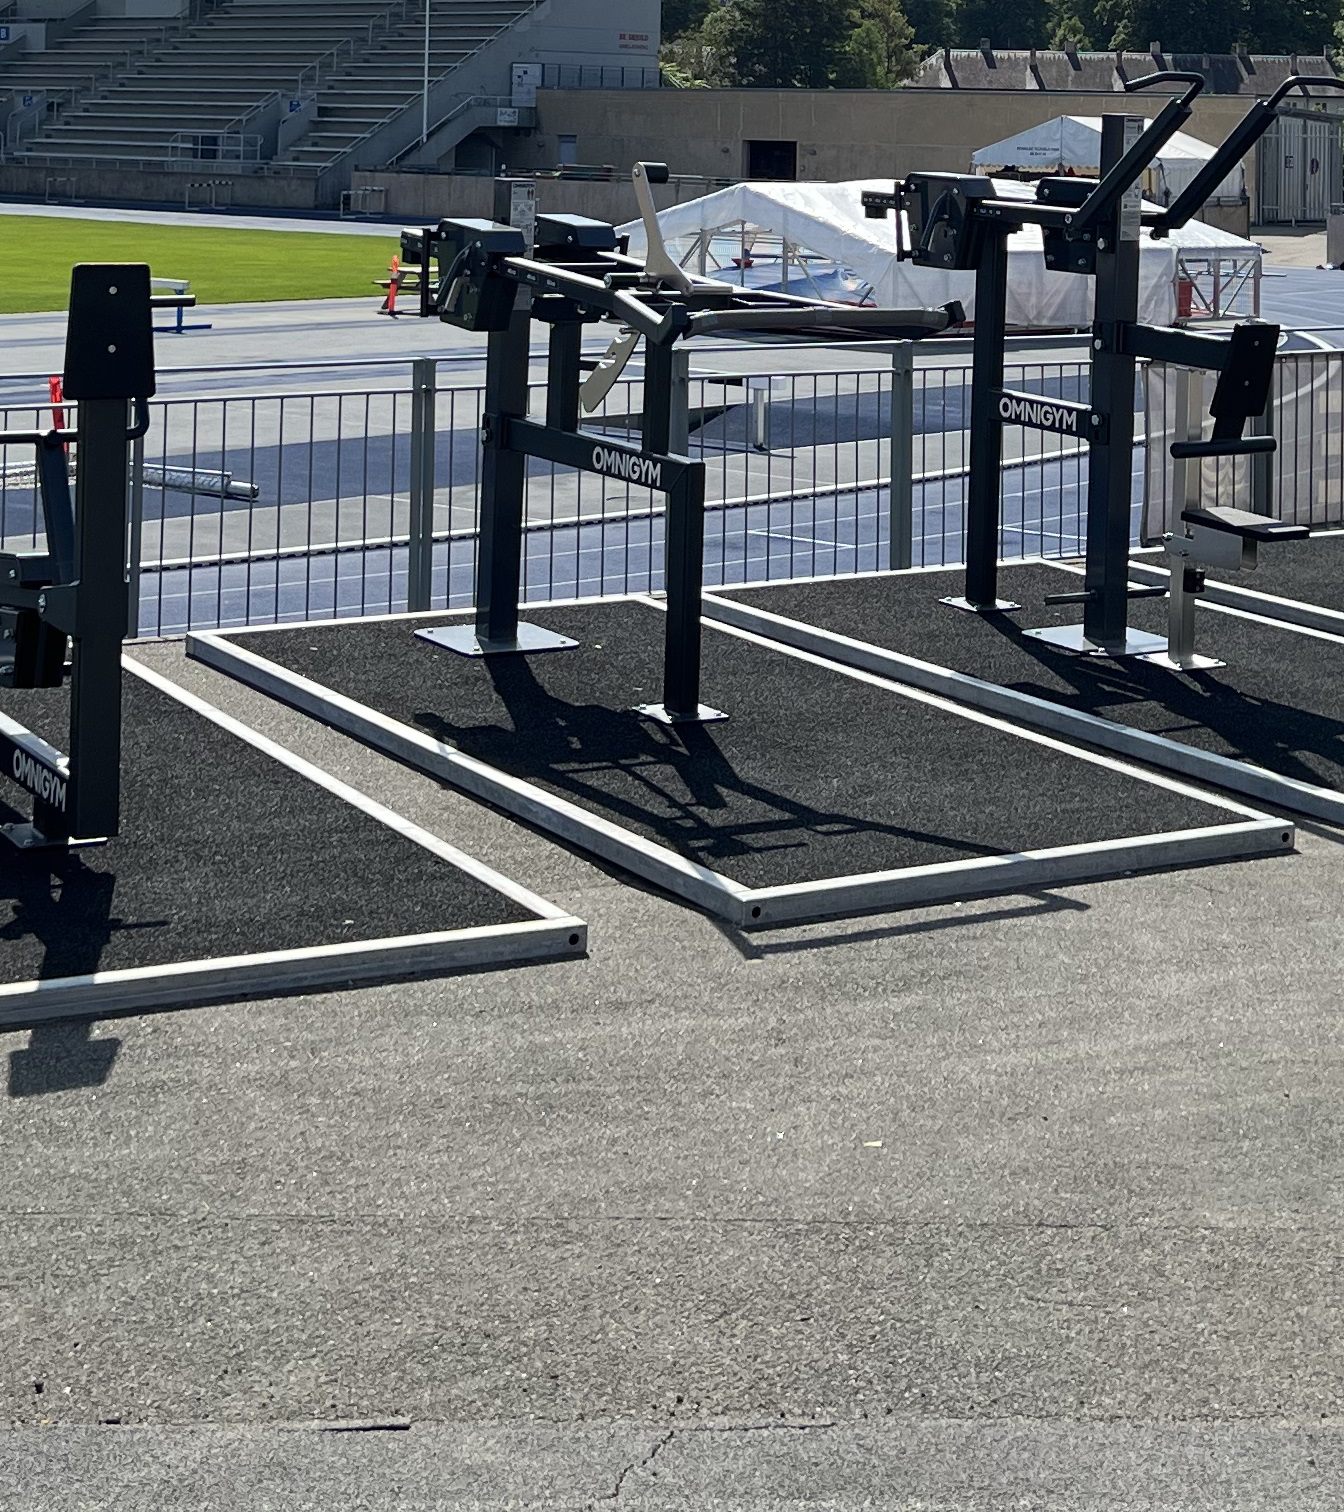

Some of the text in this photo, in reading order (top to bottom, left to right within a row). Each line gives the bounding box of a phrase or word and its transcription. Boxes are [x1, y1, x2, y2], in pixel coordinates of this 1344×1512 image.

[999, 397, 1077, 432] OMNIGYM
[592, 445, 662, 487] OMNIGYM
[12, 748, 67, 813] OMNIGYM
